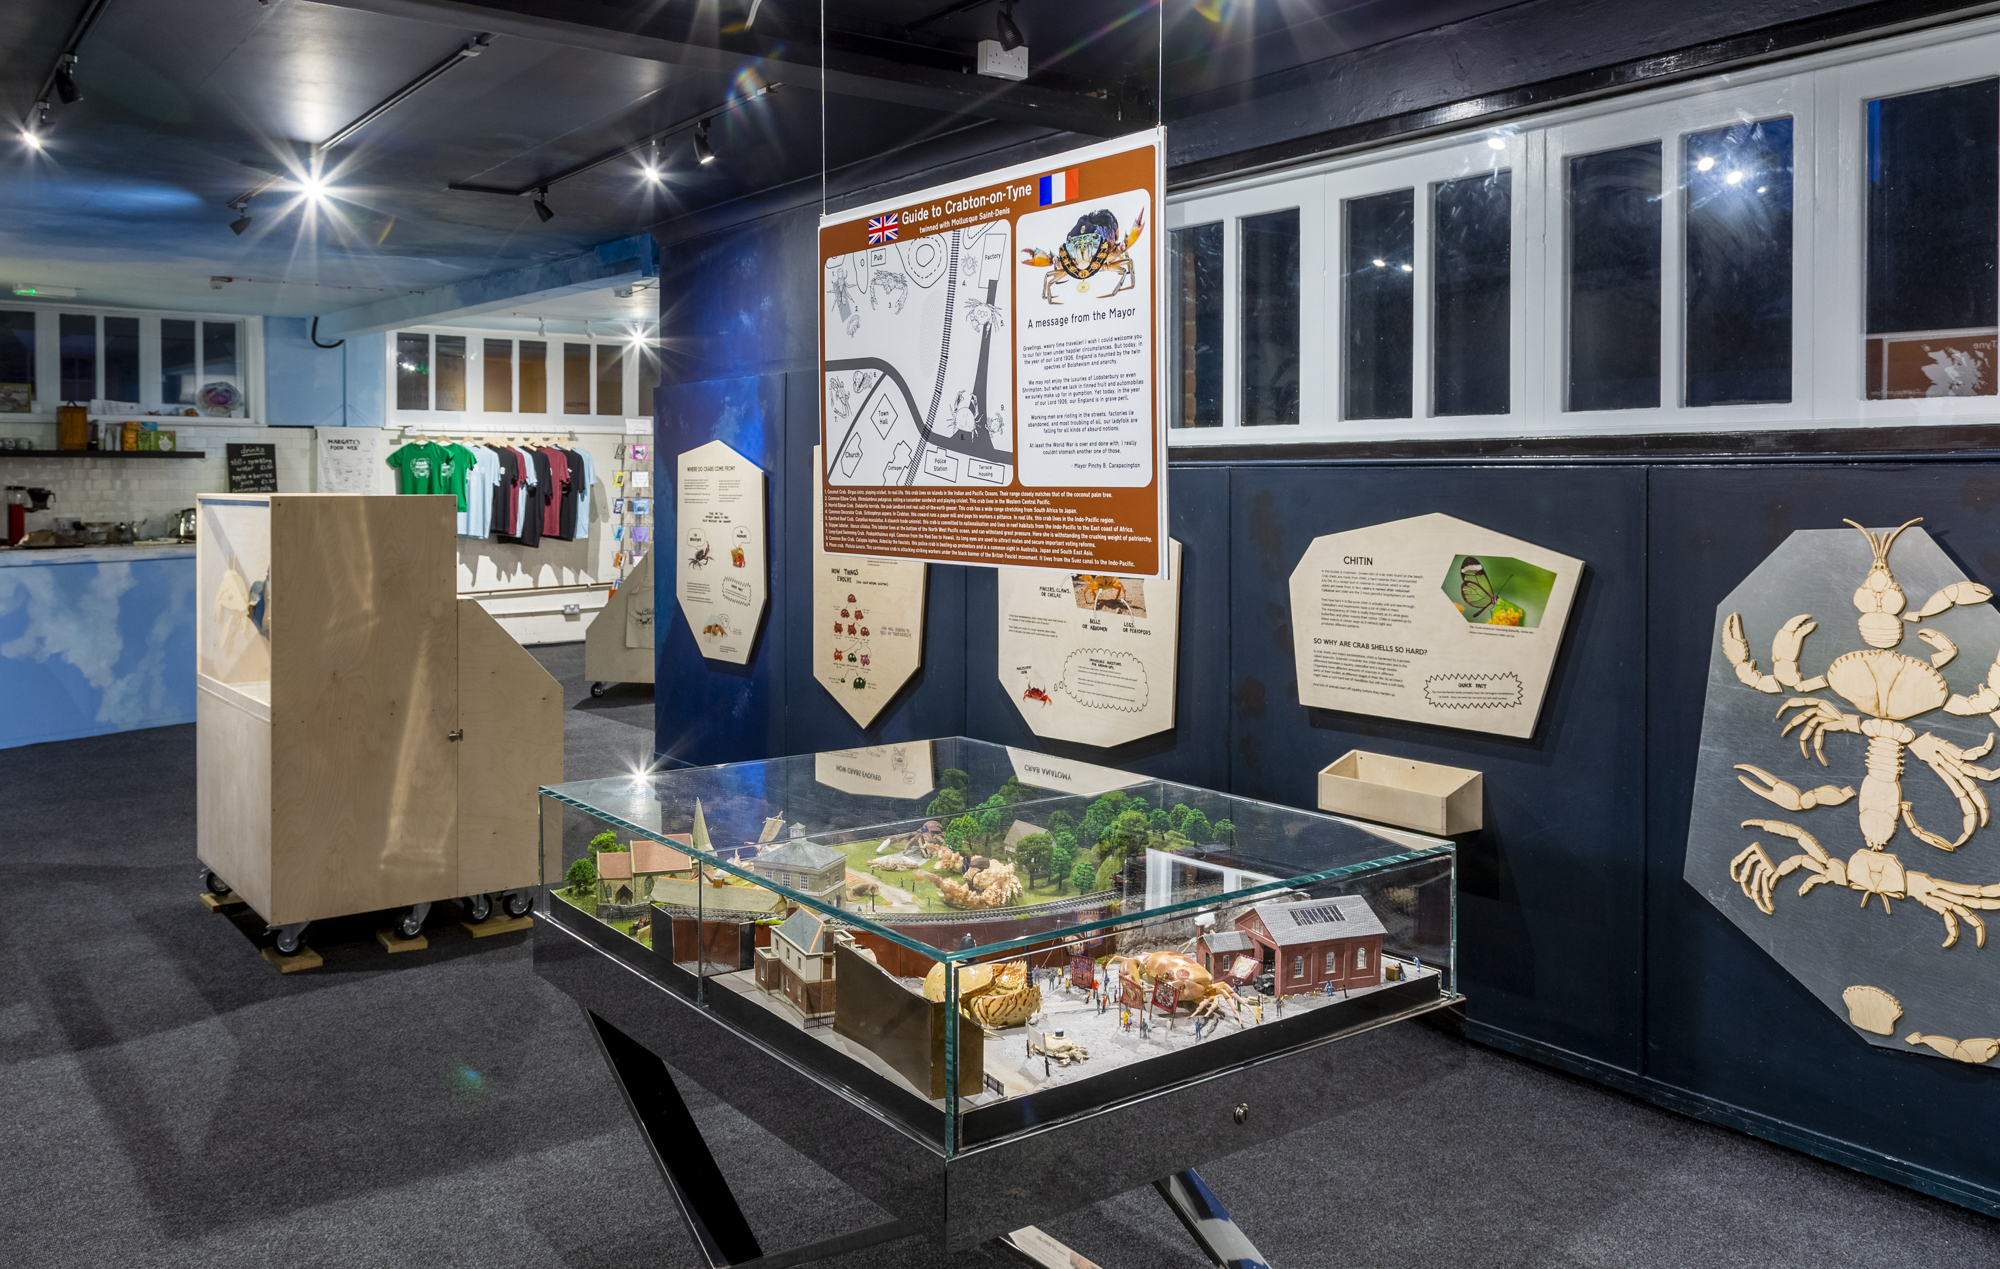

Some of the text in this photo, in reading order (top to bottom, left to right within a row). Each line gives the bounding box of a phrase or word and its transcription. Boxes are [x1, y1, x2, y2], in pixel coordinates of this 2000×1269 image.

[902, 184, 1032, 225] Guide to Crabton-on-Tyne
[919, 207, 1011, 234] twinned with Mollusque Saint-Denis
[873, 253, 883, 262] Pub
[984, 252, 1001, 261] Factory
[1027, 307, 1136, 329] A message from the Mayor
[1066, 347, 1080, 355] happier
[1123, 341, 1137, 349] today,
[1076, 353, 1092, 361] England
[1044, 363, 1060, 371] spectres
[1100, 358, 1118, 366] anarchy.
[240, 445, 265, 454] drinks
[845, 451, 860, 459] Church
[1343, 555, 1373, 566] CHITIN
[843, 568, 859, 576] THINGS
[1323, 638, 1338, 646] WHY
[1352, 641, 1370, 649] CRAB
[1370, 643, 1394, 652] SHELLS
[1405, 647, 1428, 656] HARD?
